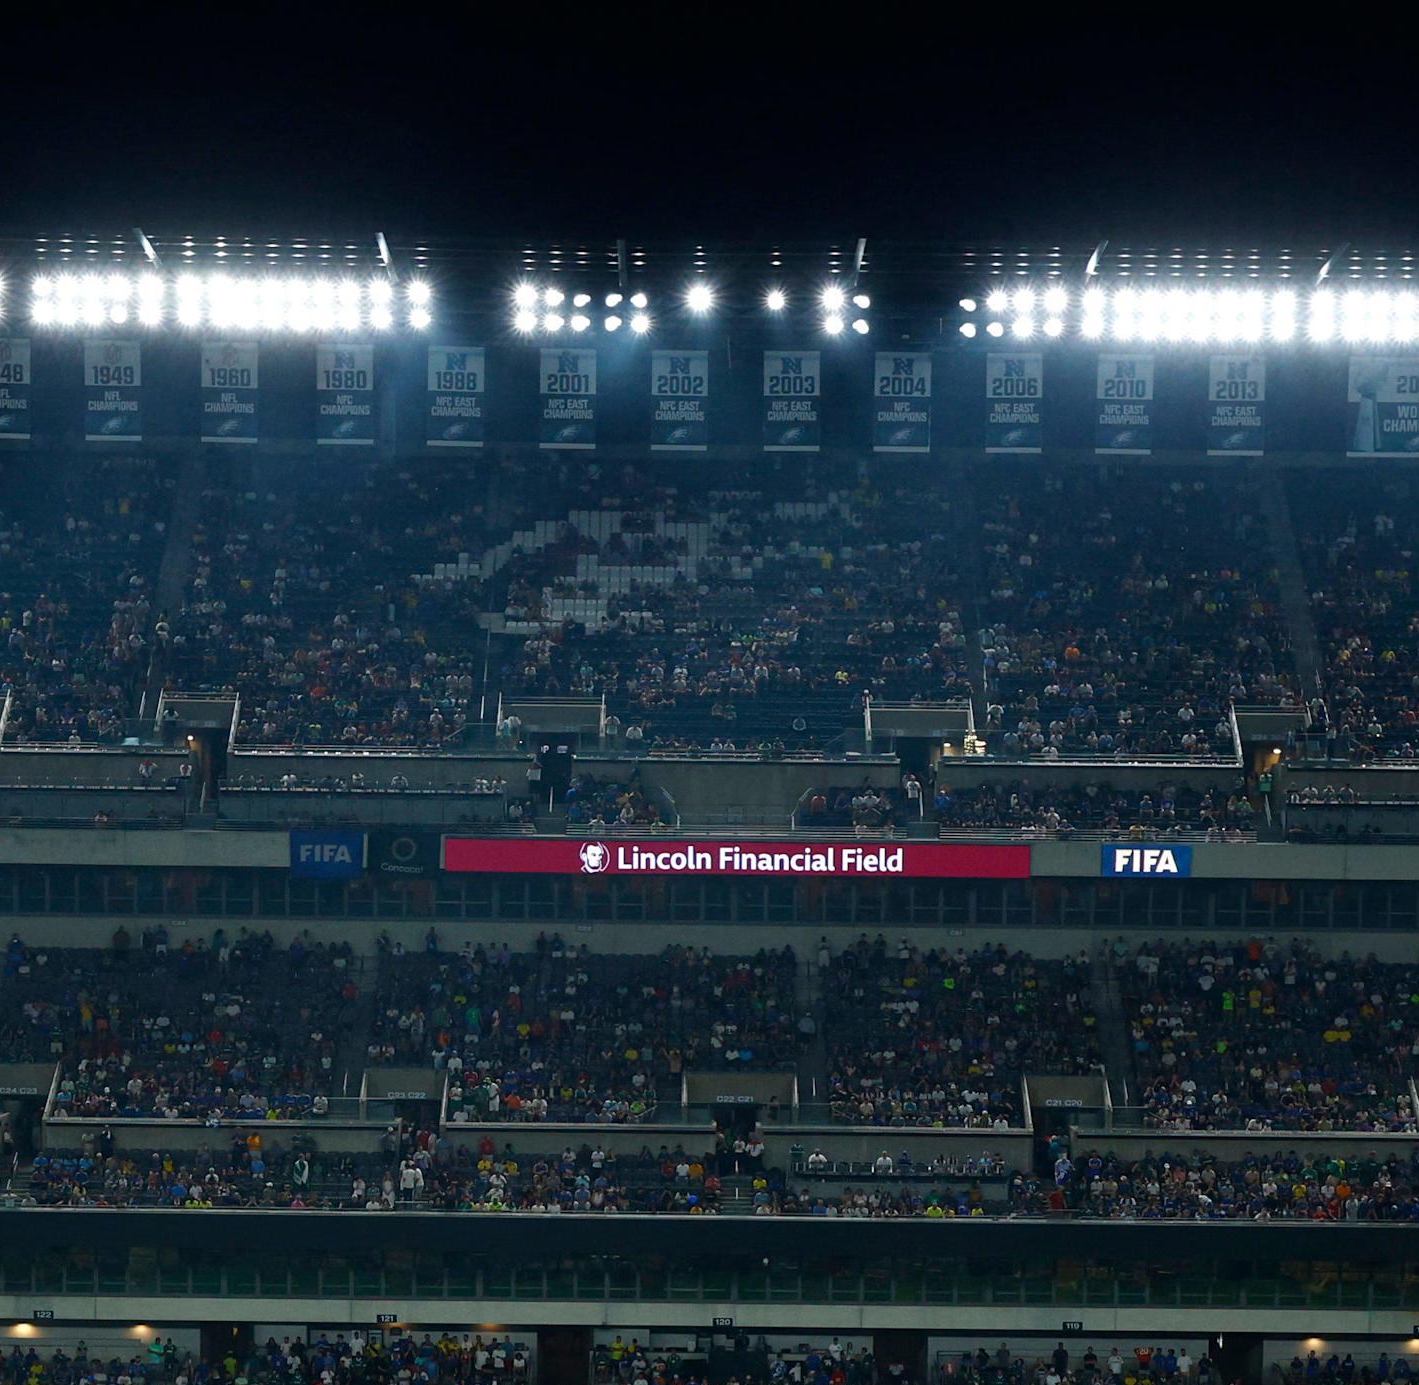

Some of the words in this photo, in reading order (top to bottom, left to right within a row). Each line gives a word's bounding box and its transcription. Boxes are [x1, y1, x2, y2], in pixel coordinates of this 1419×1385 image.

[91, 366, 135, 384] 1949
[209, 368, 251, 387] 1960
[323, 370, 368, 389] 1980
[436, 371, 478, 390] 1988
[547, 374, 590, 392] 2001
[657, 376, 703, 394] 2002
[769, 376, 815, 394] 2003
[879, 377, 926, 395] 2004
[992, 378, 1038, 396] 2006
[1104, 379, 1146, 397] 2010
[1216, 381, 1258, 399] 2013
[104, 391, 121, 401] NFL
[221, 393, 237, 403] NFL
[337, 395, 354, 405] NFC
[88, 400, 138, 411] CHAMPIONS
[436, 397, 453, 407] NFC
[455, 398, 476, 407] EAST
[548, 399, 566, 409] NFC
[567, 400, 588, 409] EAST
[660, 401, 678, 410] NFC
[679, 401, 700, 410] EAST
[772, 401, 790, 410] NFC
[791, 401, 812, 410] EAST
[894, 402, 911, 412] NFC
[204, 403, 254, 413] CHAMPIONS
[320, 404, 370, 416] CHAMPIONS
[431, 406, 481, 417] CHAMPIONS
[994, 403, 1012, 413] NFC
[1014, 403, 1035, 413] EAST
[1105, 405, 1122, 414] NFC
[1124, 405, 1145, 414] EAST
[1216, 406, 1234, 416] NFC
[1236, 406, 1256, 416] EAST
[543, 409, 593, 419] CHAMPIONS
[655, 410, 704, 421] CHAMPIONS
[767, 410, 817, 421] CHAMPIONS
[878, 411, 928, 422] CHAMPIONS
[989, 413, 1039, 424] CHAMPIONS
[1100, 414, 1149, 424] CHAMPIONS
[1211, 416, 1262, 427] CHAMPIONS
[300, 844, 352, 863] FIFA
[617, 847, 710, 870] Lincoln
[719, 847, 835, 871] Financial
[842, 849, 902, 872] Field
[1115, 849, 1178, 873] FIFA
[36, 1311, 52, 1319] 122
[380, 1314, 394, 1323] 121
[714, 1319, 730, 1327] 120
